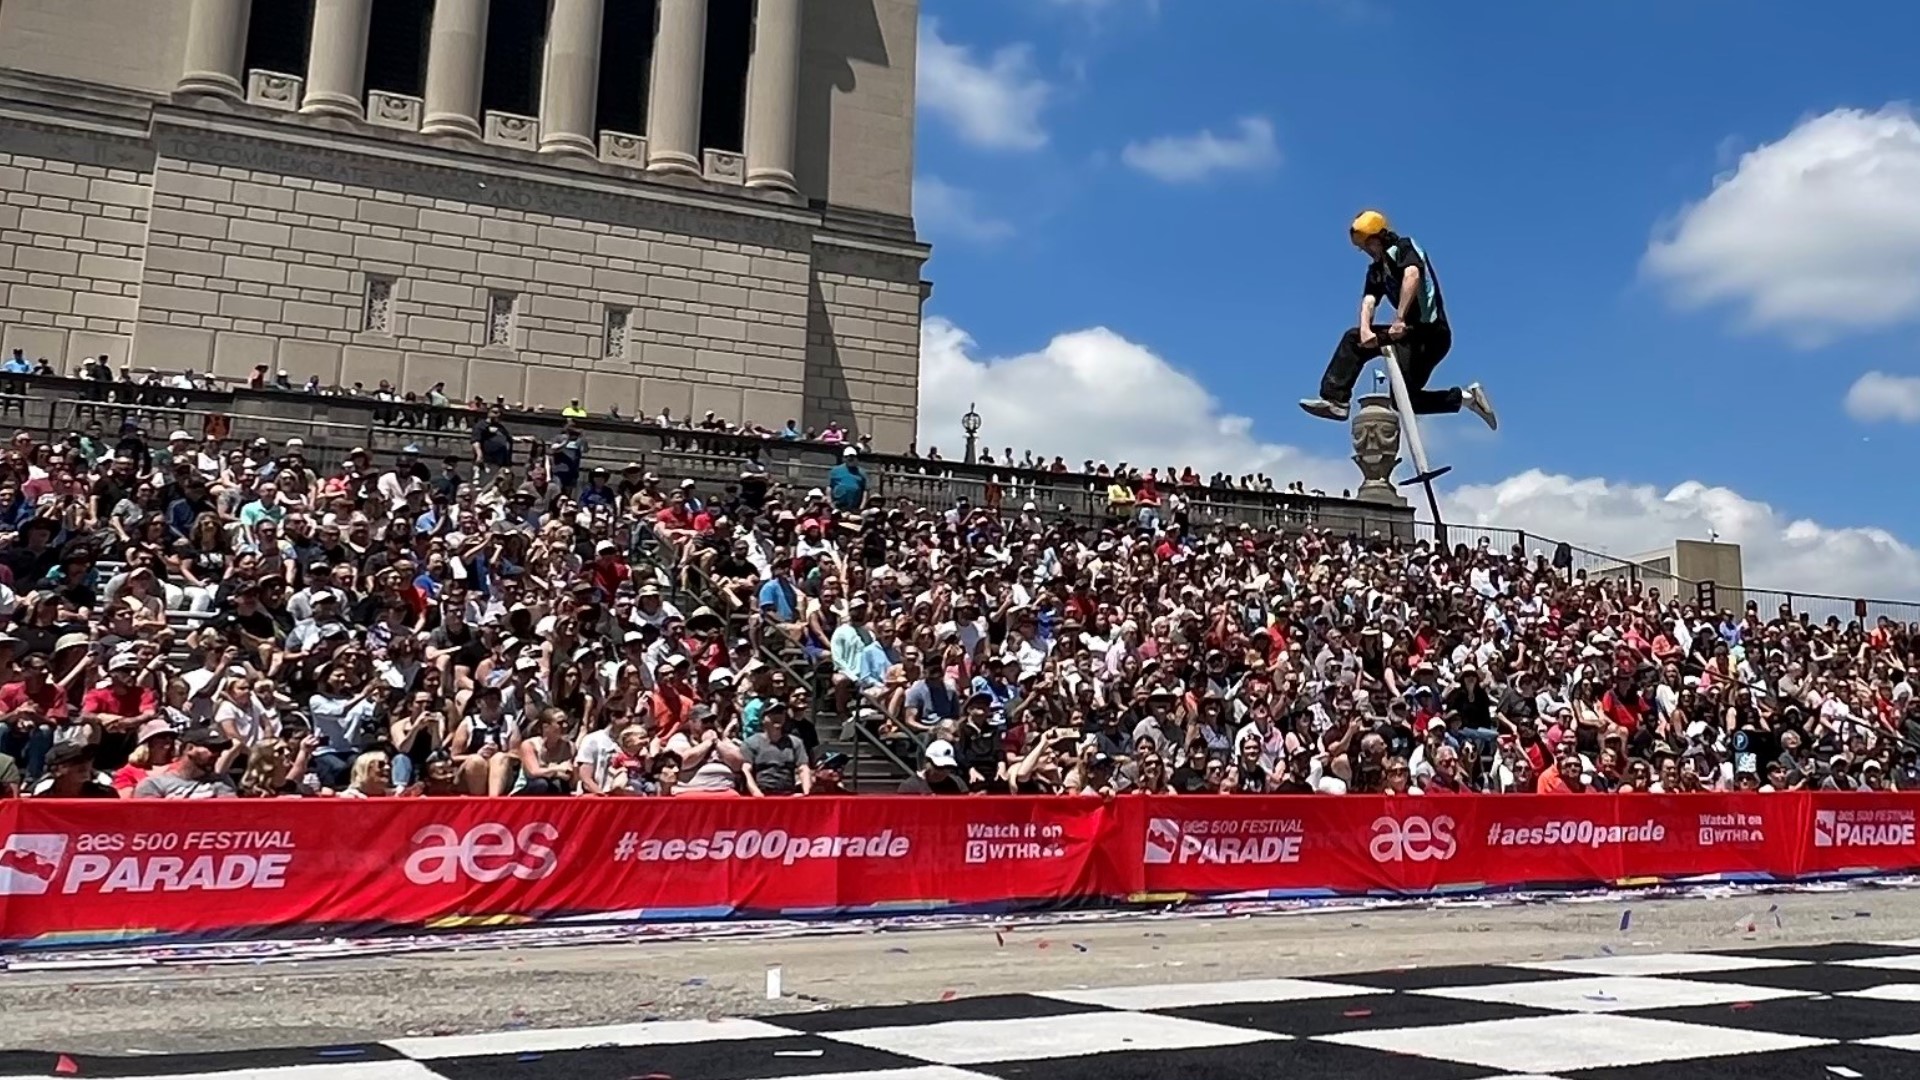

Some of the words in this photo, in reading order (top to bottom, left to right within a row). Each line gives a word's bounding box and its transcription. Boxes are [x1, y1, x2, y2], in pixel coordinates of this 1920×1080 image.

[169, 139, 199, 157] TO
[207, 144, 372, 183] COMMEMORATE
[377, 170, 414, 189] THE
[489, 187, 532, 208] AND
[661, 213, 690, 232] ALL
[967, 823, 1019, 837] Watch
[1024, 823, 1036, 837] it
[1042, 825, 1062, 837] on
[1182, 821, 1208, 834] aes
[1211, 820, 1239, 834] 500
[1240, 819, 1304, 833] FESTIVAL
[1487, 819, 1665, 848] #aes500parade
[1699, 814, 1735, 826] Watch
[1737, 814, 1747, 826] it
[76, 833, 125, 852] aes
[131, 832, 179, 851] 500
[183, 830, 296, 850] FESTIVAL
[614, 829, 910, 866] #aes500parade
[1369, 815, 1457, 863] aes
[1837, 823, 1916, 847] PARADE
[403, 822, 559, 886] aes
[989, 843, 1041, 860] WTHR
[1178, 836, 1303, 865] PARADE
[62, 853, 293, 894] PARADE
